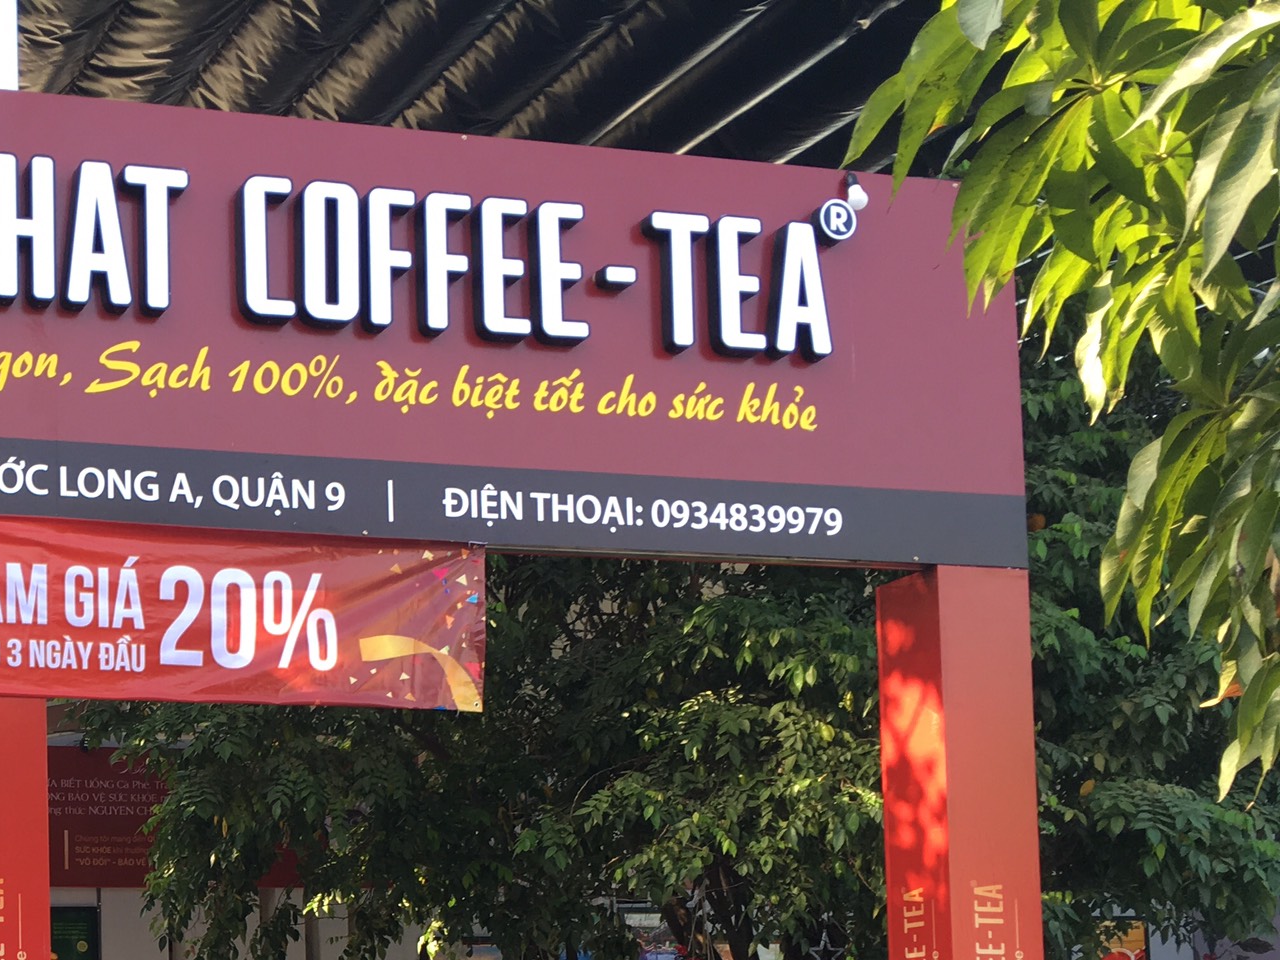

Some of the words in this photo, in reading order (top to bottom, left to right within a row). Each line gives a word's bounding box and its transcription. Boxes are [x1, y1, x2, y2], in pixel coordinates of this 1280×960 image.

[84, 340, 211, 398] Sạch
[228, 354, 358, 404] 100%,
[373, 361, 438, 413] đặc
[451, 365, 521, 419] biệt
[534, 368, 585, 413] tốt
[597, 374, 656, 417] cho
[668, 381, 725, 420] sức
[737, 382, 818, 432] khỏe
[59, 466, 160, 501] LONG
[168, 472, 204, 508] A,
[212, 472, 316, 516] QUẬN
[325, 481, 346, 512] 9
[442, 483, 523, 527] ĐIỆN
[529, 491, 643, 534] THOẠI:
[651, 499, 843, 536] 0934839979
[64, 556, 146, 630] GIÁ
[158, 564, 339, 672] 20%
[7, 638, 22, 668] 3
[29, 634, 94, 670] NGÀY
[98, 634, 147, 673] ĐẦU
